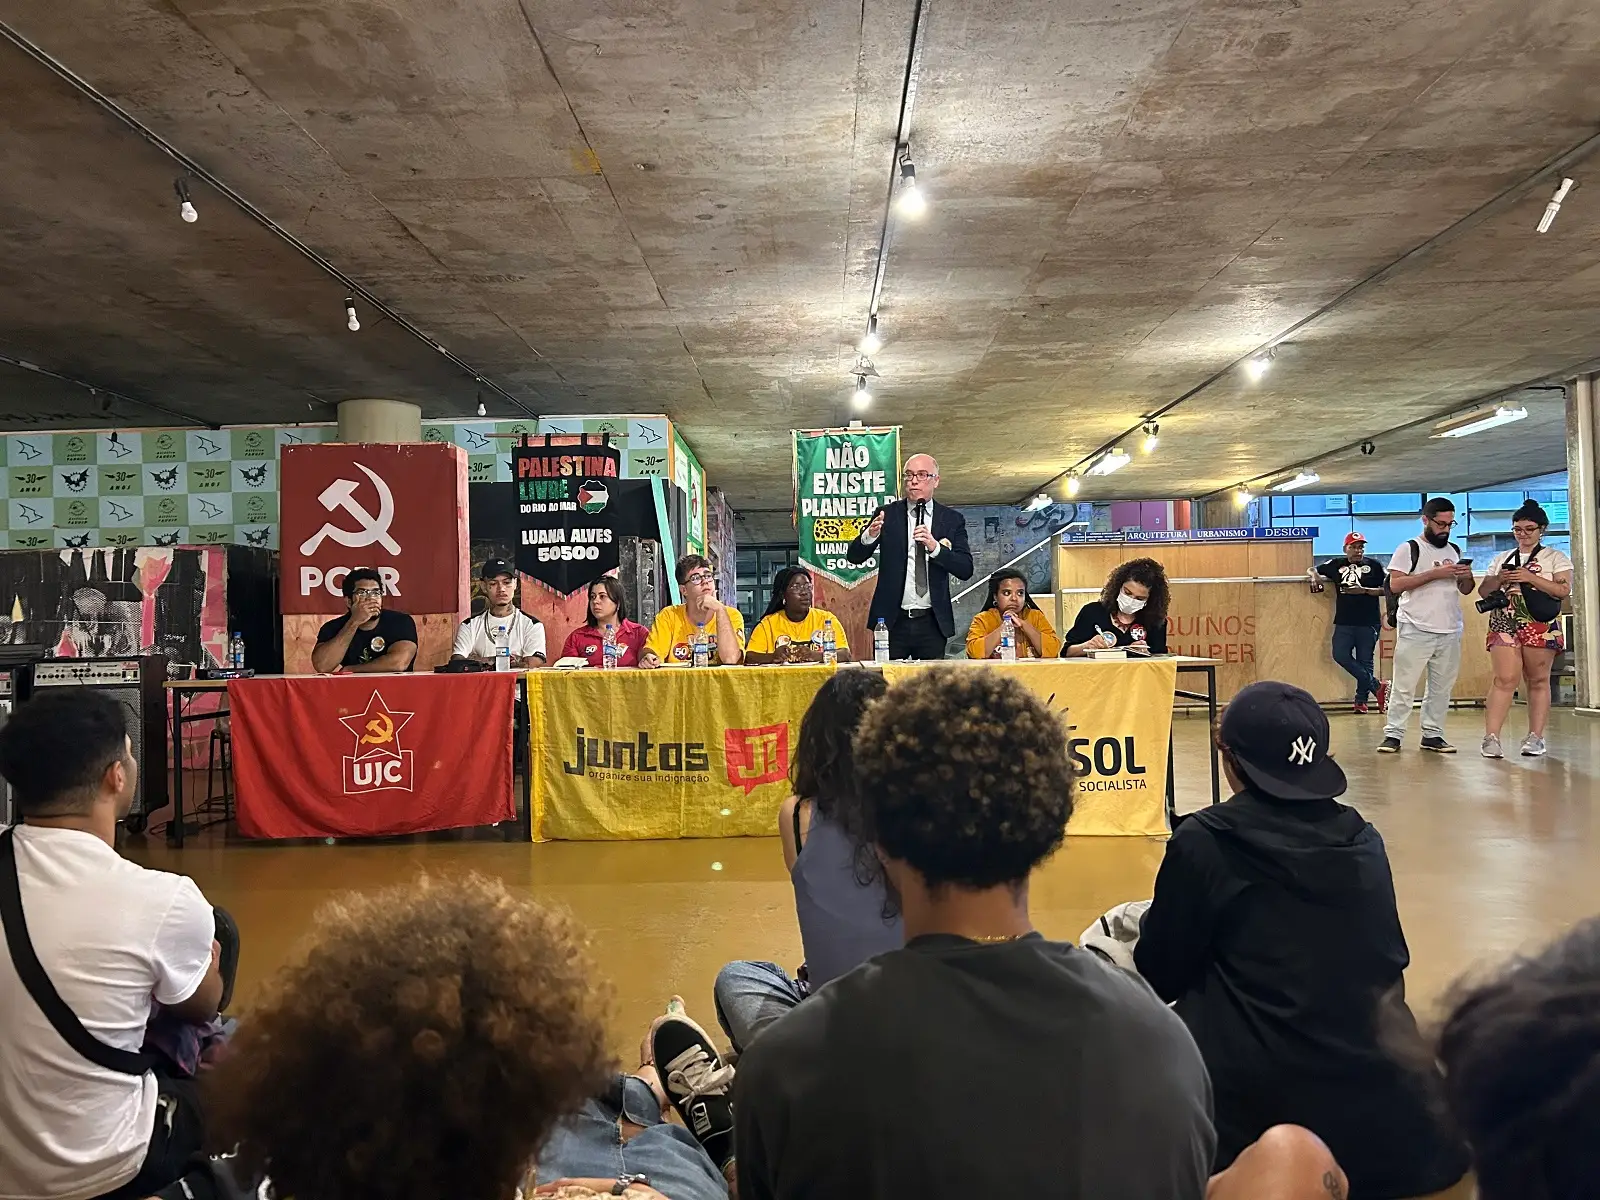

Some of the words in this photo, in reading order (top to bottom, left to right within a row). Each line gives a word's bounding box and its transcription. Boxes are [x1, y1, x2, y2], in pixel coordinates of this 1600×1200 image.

[645, 456, 655, 466] 30
[826, 442, 870, 469] NÃO
[472, 462, 483, 472] 30
[519, 455, 617, 478] PALESTINA
[25, 473, 36, 484] 30
[115, 472, 126, 482] 30
[205, 469, 215, 479] 30
[519, 479, 569, 500] LIVRE
[813, 471, 886, 495] EXISTE
[520, 504, 531, 513] DO
[532, 503, 546, 512] RIO
[548, 502, 558, 512] AO
[560, 502, 577, 511] MAR
[801, 496, 878, 517] PLANETA
[521, 528, 566, 545] LUANA
[570, 528, 613, 543] ALVES
[1127, 531, 1188, 540] ARQUITETURA
[1197, 529, 1248, 538] URBANISMO
[1264, 527, 1309, 537] DESIGN
[538, 545, 599, 562] 50500
[815, 543, 849, 555] LUANA
[300, 566, 402, 597] PCR
[674, 647, 688, 656] 50
[563, 727, 709, 776] juntos
[1288, 735, 1317, 765] NY
[353, 760, 402, 787] UJC
[588, 770, 632, 782] organize
[634, 774, 652, 783] sua
[655, 773, 709, 784] indignação
[1079, 779, 1147, 792] SOCIALISTA
